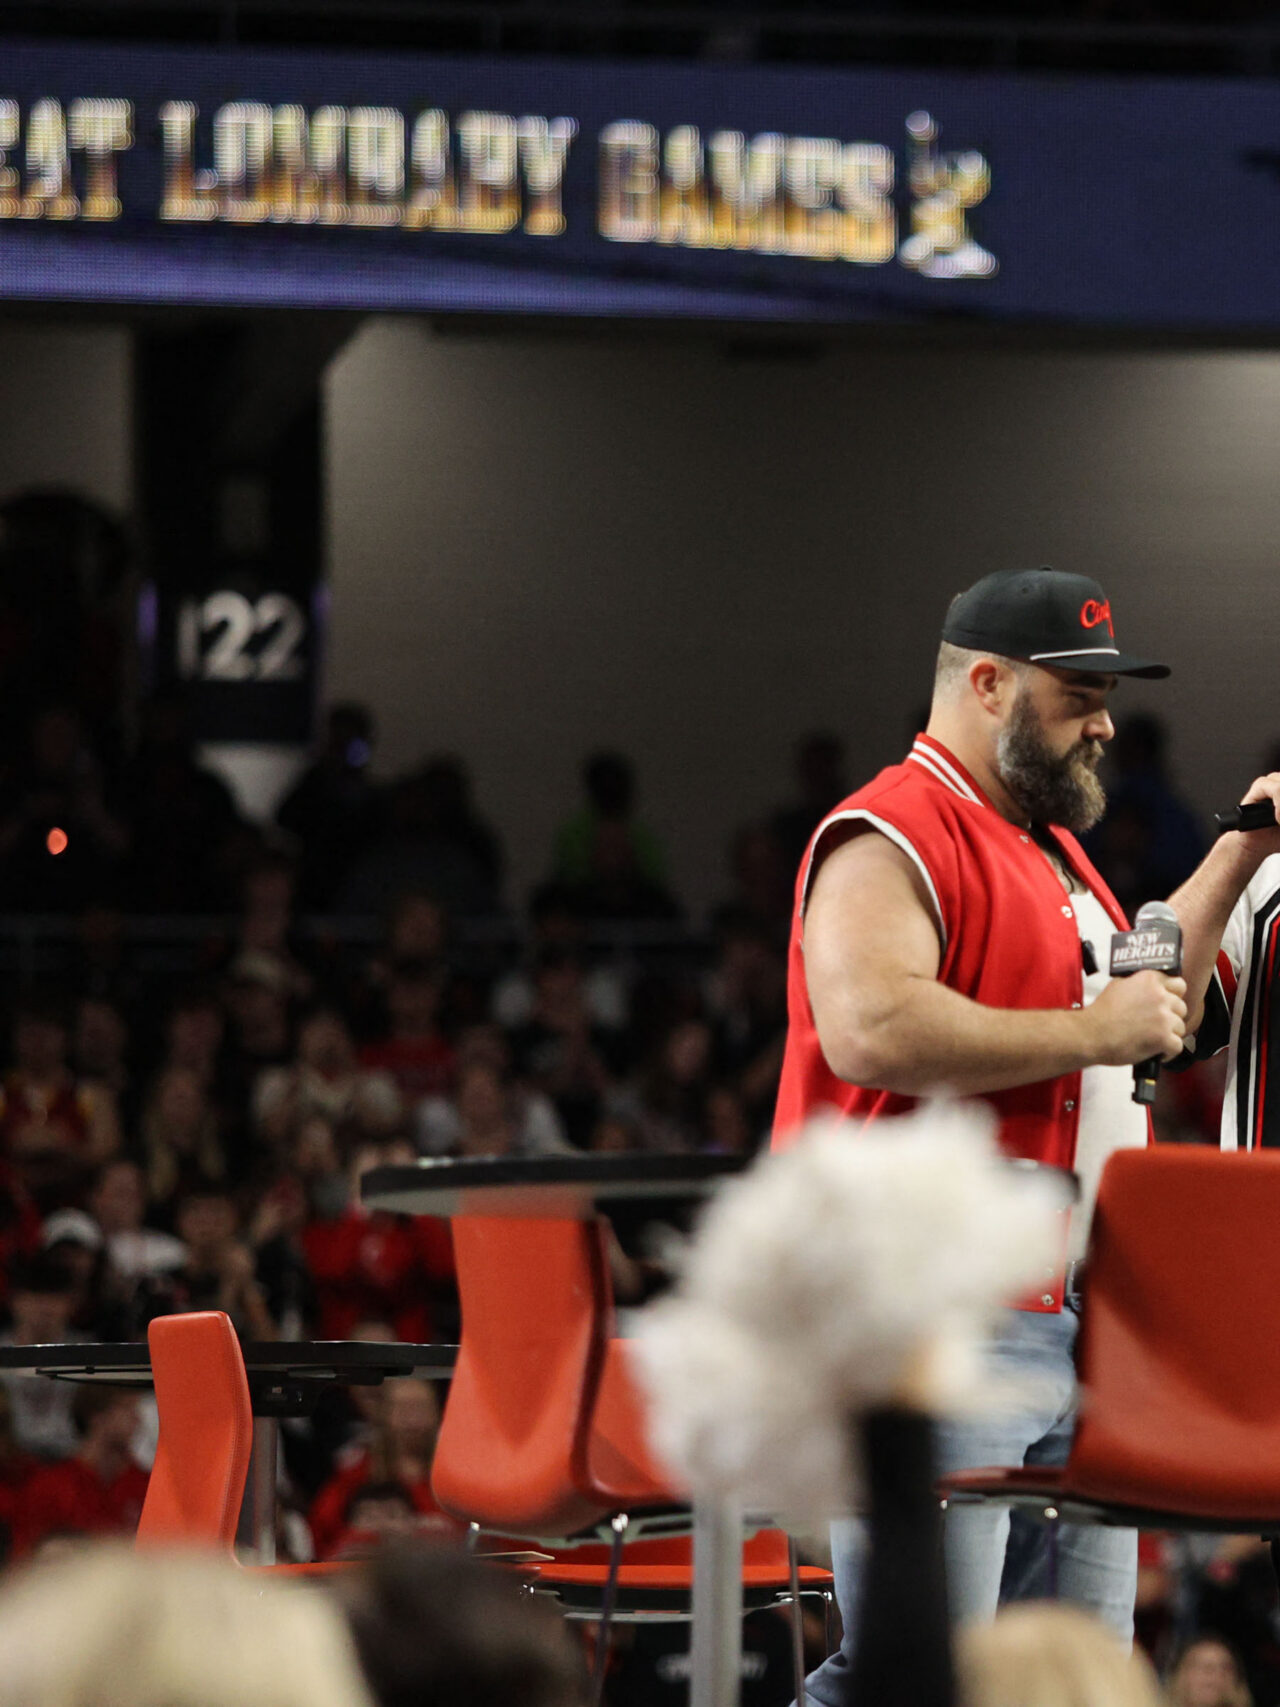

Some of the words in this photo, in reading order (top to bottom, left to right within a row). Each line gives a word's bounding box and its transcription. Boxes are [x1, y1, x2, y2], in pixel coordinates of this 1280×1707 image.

[600, 120, 895, 263] GAMES
[176, 590, 304, 682] 122
[1113, 943, 1175, 961] HEIGHTS
[1127, 931, 1161, 947] NEW
